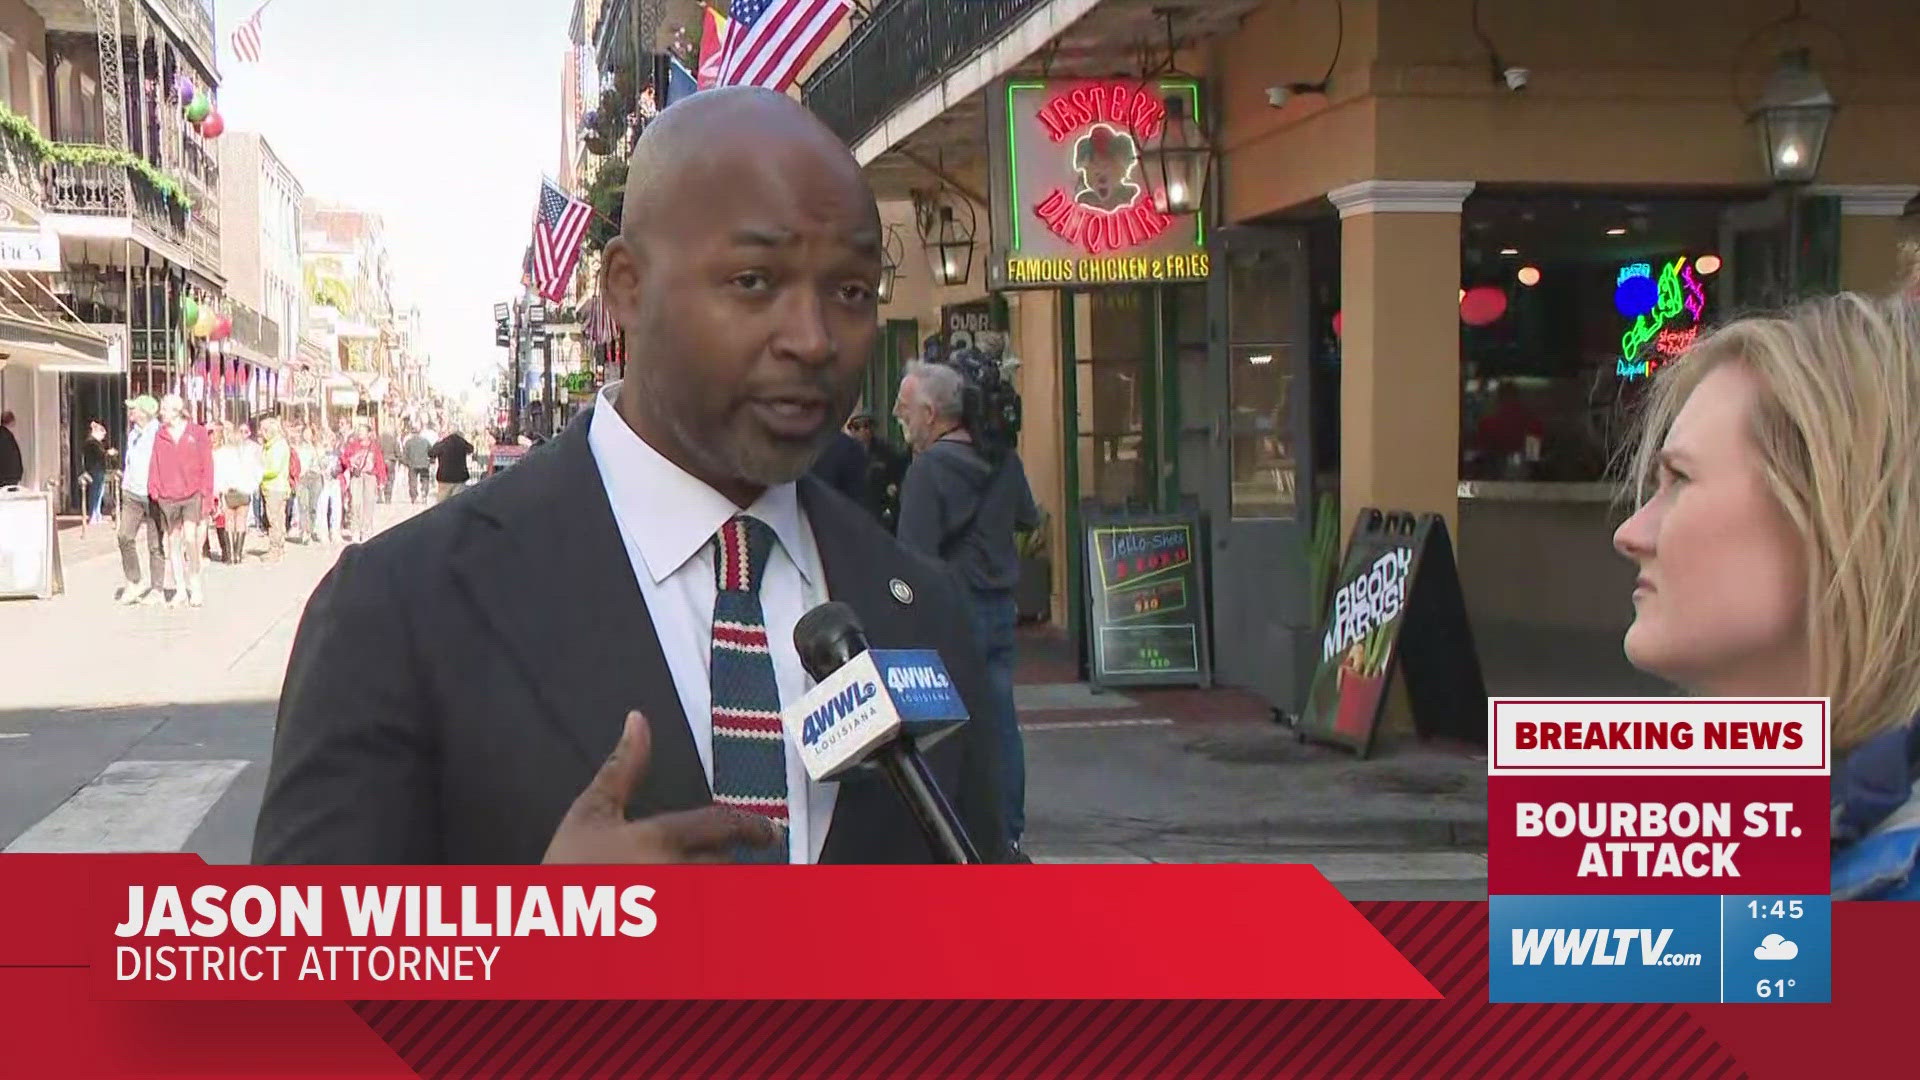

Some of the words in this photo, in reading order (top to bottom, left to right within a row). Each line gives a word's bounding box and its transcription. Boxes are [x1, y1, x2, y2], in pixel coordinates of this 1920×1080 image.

[1007, 258, 1073, 282] FAMOUS
[1078, 257, 1148, 281] CHICKEN
[1166, 254, 1210, 278] FRIES
[1335, 547, 1412, 621] BLOODY
[899, 692, 950, 705] LOUISIANA
[814, 707, 877, 755] LOUISIANA
